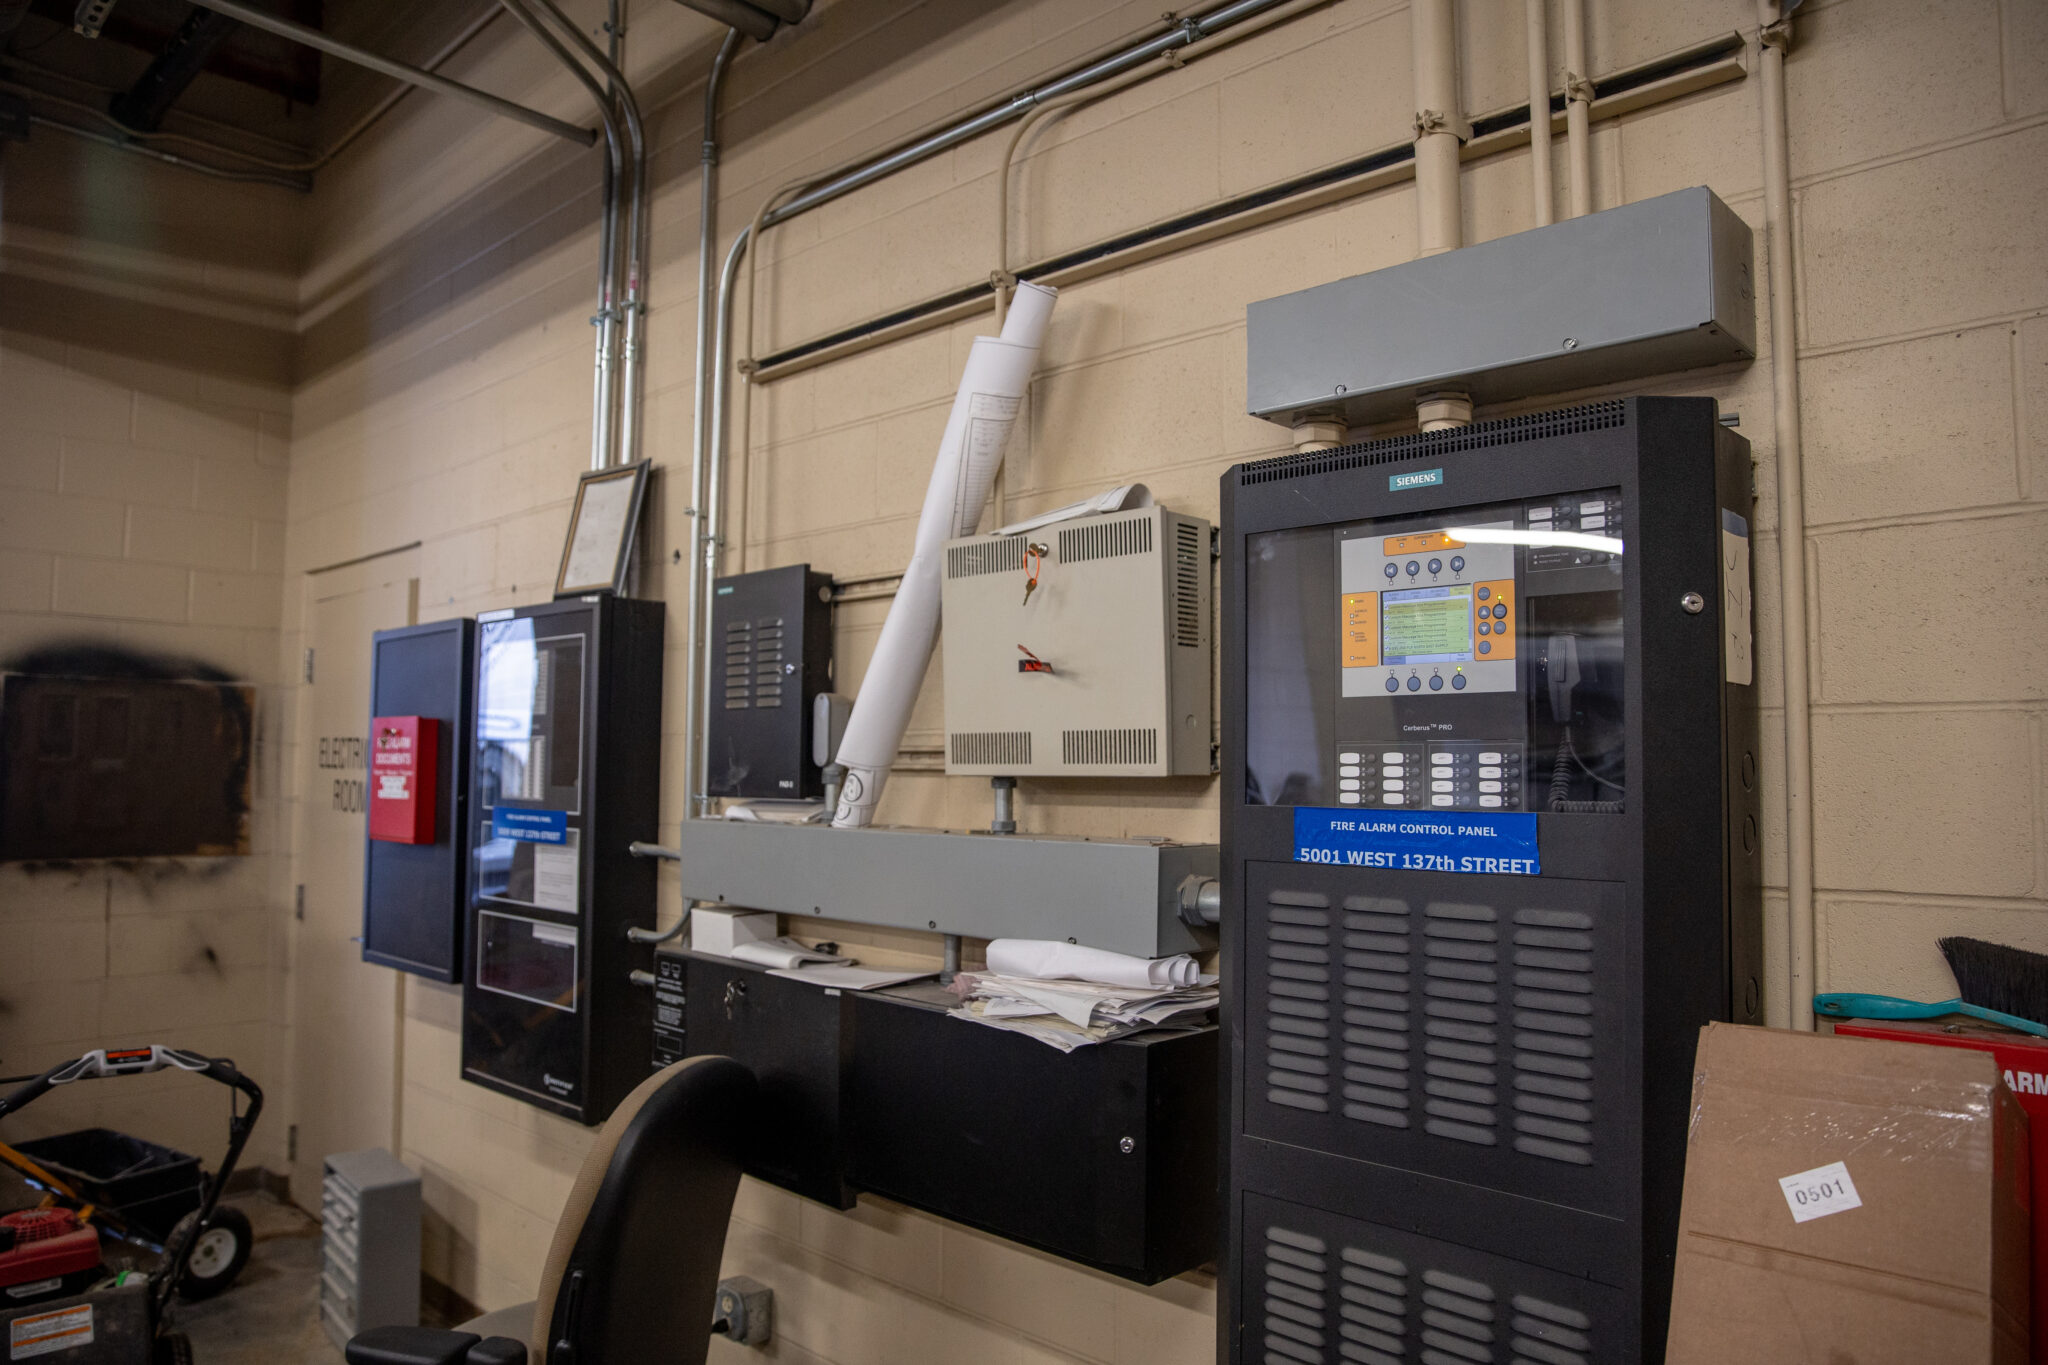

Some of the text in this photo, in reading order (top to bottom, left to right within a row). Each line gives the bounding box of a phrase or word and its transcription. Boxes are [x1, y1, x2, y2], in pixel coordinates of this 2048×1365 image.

[1396, 472, 1436, 487] SIEMENS
[1330, 821, 1498, 837] FIRE ALARM CONTROL PANEL
[1300, 847, 1534, 874] 5001 WEST 137th STREET
[1795, 1178, 1844, 1206] 0501
